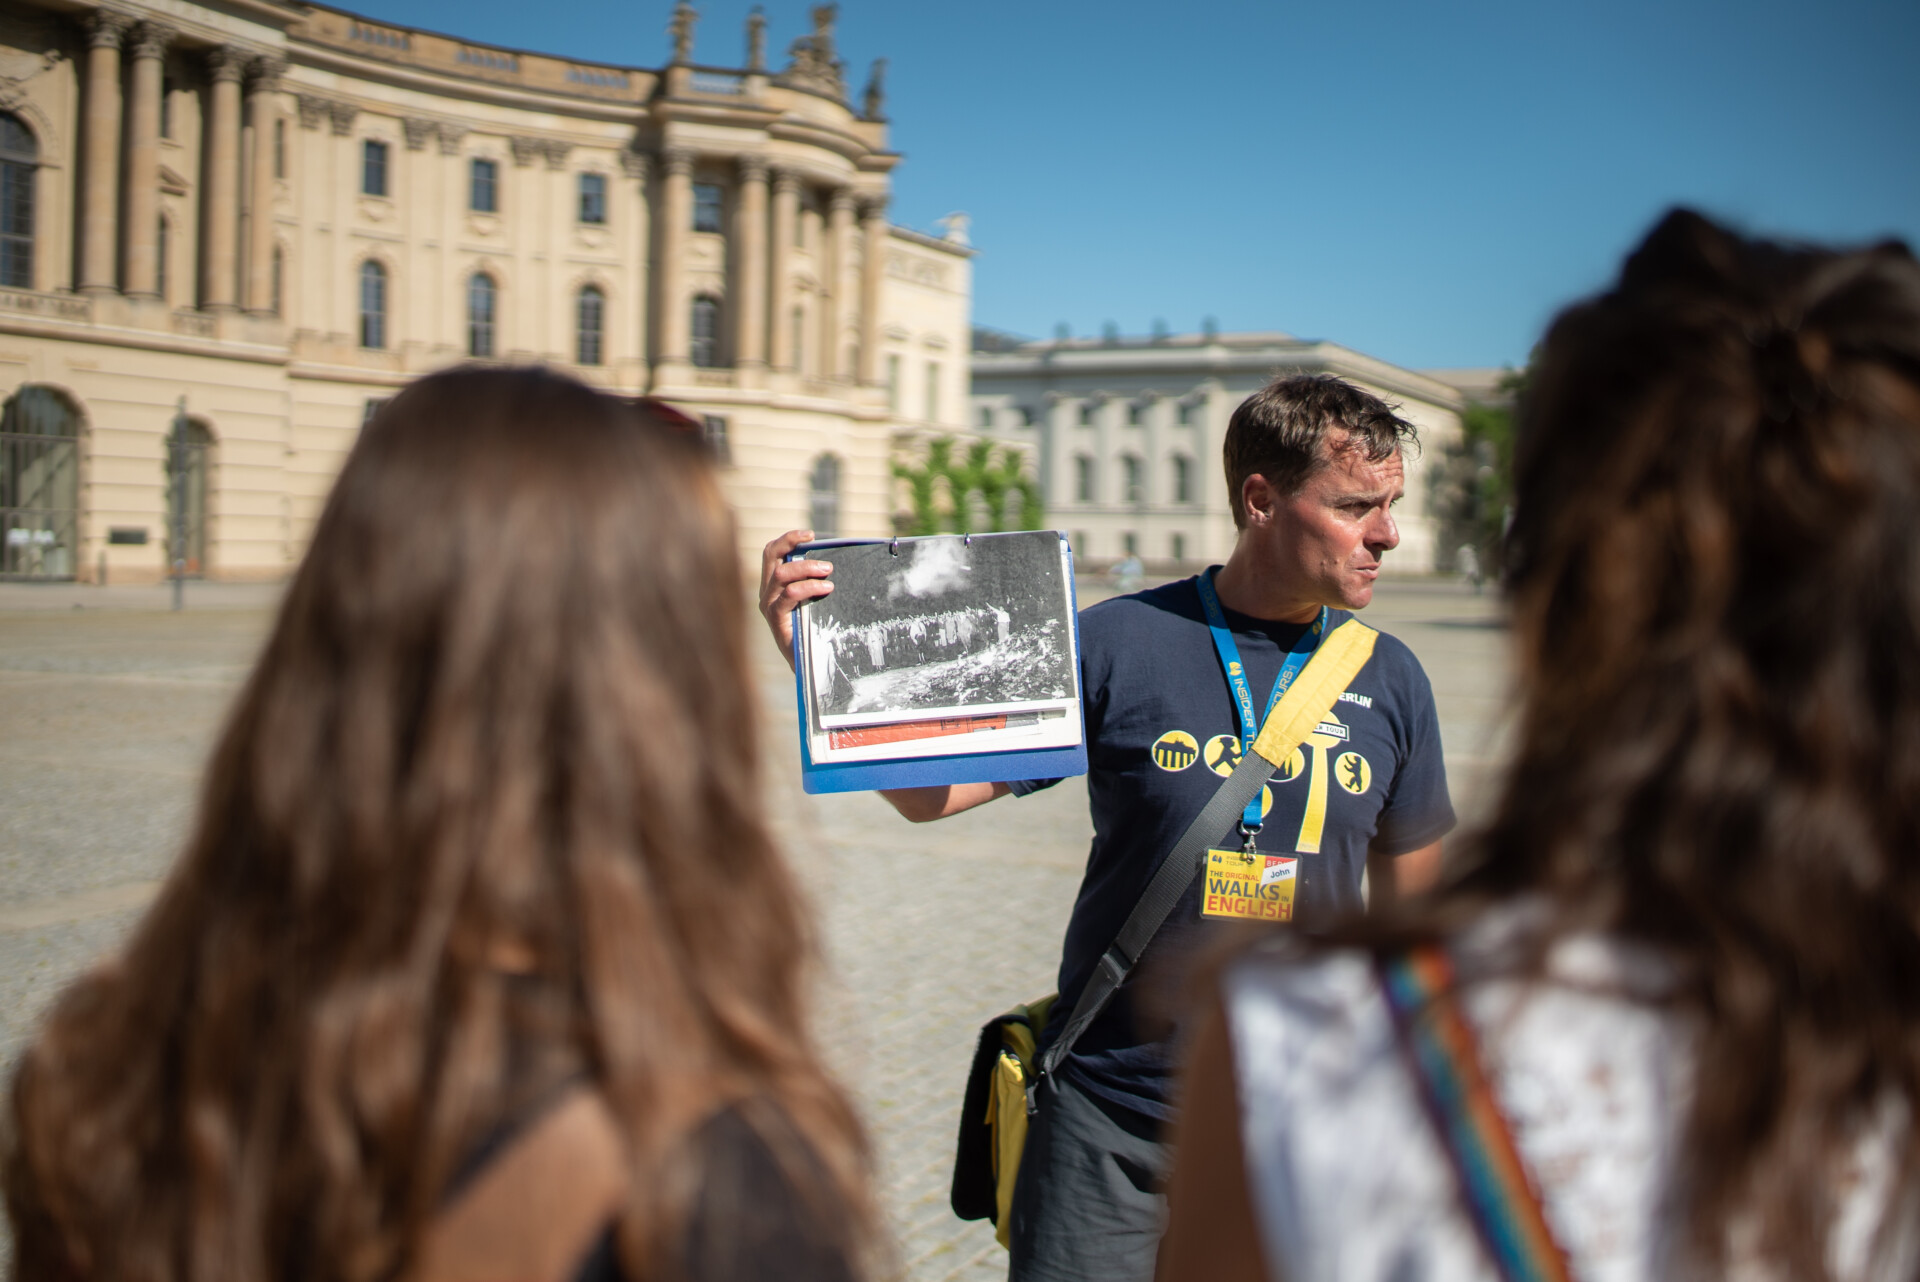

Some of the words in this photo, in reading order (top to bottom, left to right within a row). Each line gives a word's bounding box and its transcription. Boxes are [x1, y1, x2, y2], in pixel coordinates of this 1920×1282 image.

[1234, 678, 1254, 728] INSIDER
[1338, 691, 1372, 709] ERLIN
[1326, 726, 1344, 735] TOUR
[1225, 871, 1260, 882] ORIGINAL
[1271, 869, 1290, 878] John
[1209, 878, 1280, 901] WALKS
[1207, 895, 1291, 919] ENGLISH
